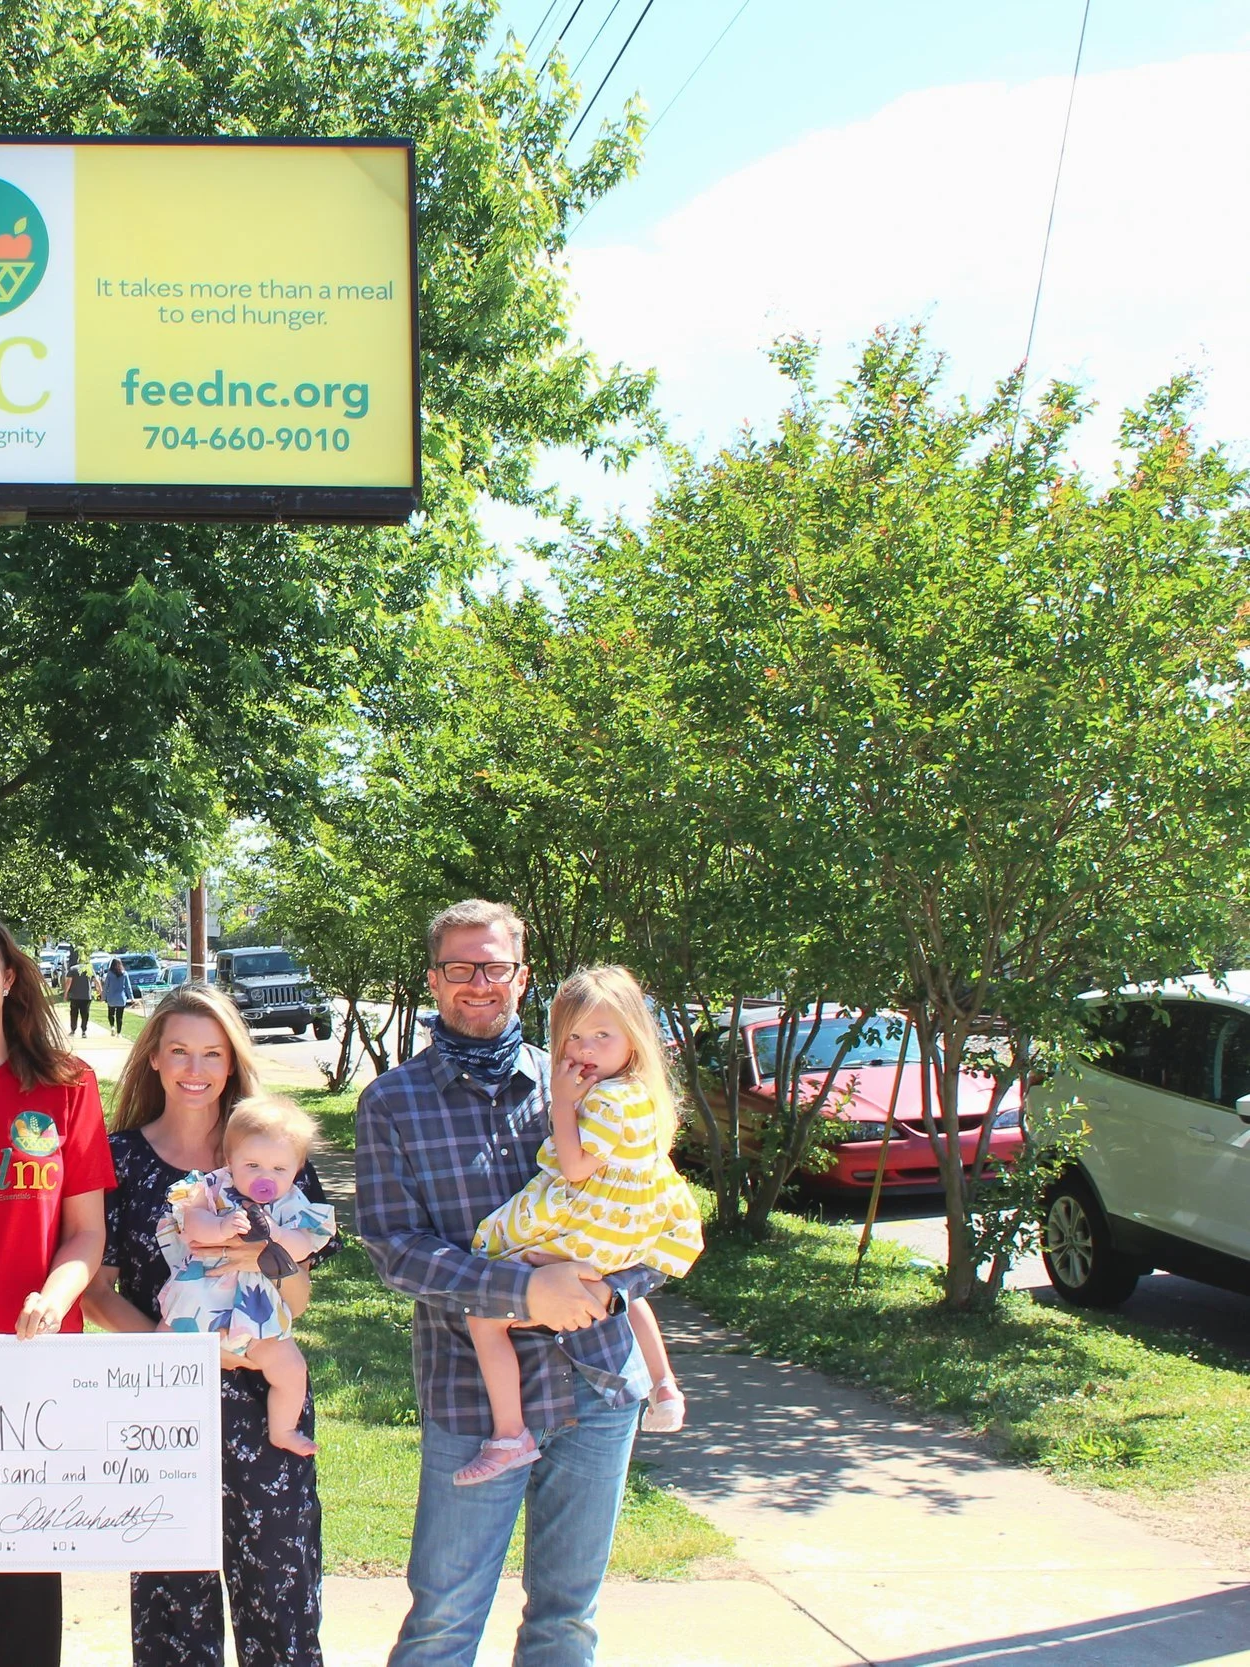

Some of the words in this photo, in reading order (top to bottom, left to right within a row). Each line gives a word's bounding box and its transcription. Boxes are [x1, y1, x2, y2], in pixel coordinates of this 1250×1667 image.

[96, 277, 112, 297] It
[119, 277, 183, 298] takes
[190, 282, 252, 299] more
[258, 279, 312, 299] than
[318, 284, 331, 300] a
[337, 280, 393, 300] meal
[158, 306, 184, 324] to
[191, 304, 236, 324] end
[242, 305, 328, 331] hunger.
[121, 368, 369, 419] feednc.org
[142, 426, 350, 452] 704-660-9010
[72, 1378, 99, 1389] Date
[107, 1367, 141, 1398] May
[146, 1361, 169, 1388] 14,
[170, 1362, 204, 1386] 2021
[0, 1399, 63, 1451] NC
[120, 1425, 199, 1451] $300,000
[61, 1465, 87, 1482] and
[159, 1469, 197, 1480] Dollars
[52, 1540, 76, 1551] 101
